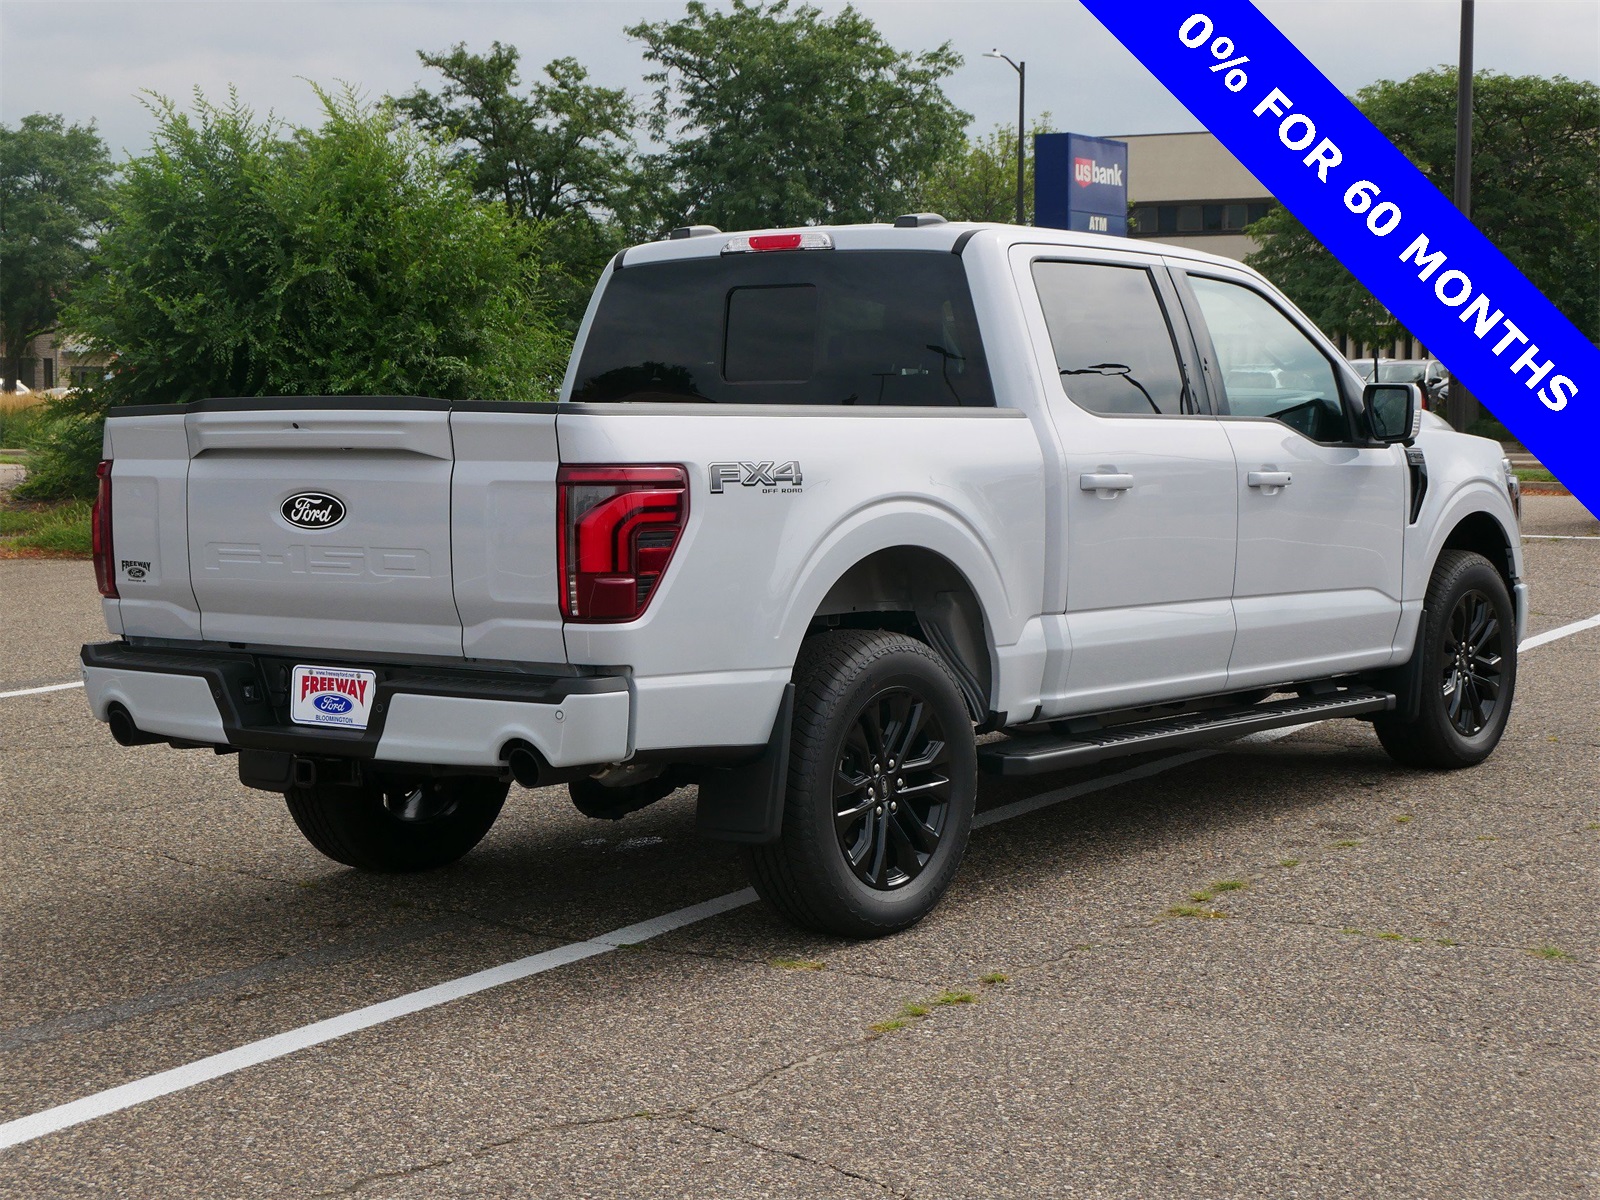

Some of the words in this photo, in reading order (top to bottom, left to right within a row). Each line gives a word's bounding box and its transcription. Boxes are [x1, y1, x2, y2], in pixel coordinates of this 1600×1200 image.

[1089, 216, 1107, 232] ATM
[708, 460, 803, 494] FX4
[291, 497, 332, 523] Ford
[121, 560, 151, 572] FREEWAY
[204, 541, 433, 579] F-150
[301, 675, 368, 708] FREEWAY
[320, 696, 345, 712] Ford
[315, 714, 353, 724] BLOOMINGTON
